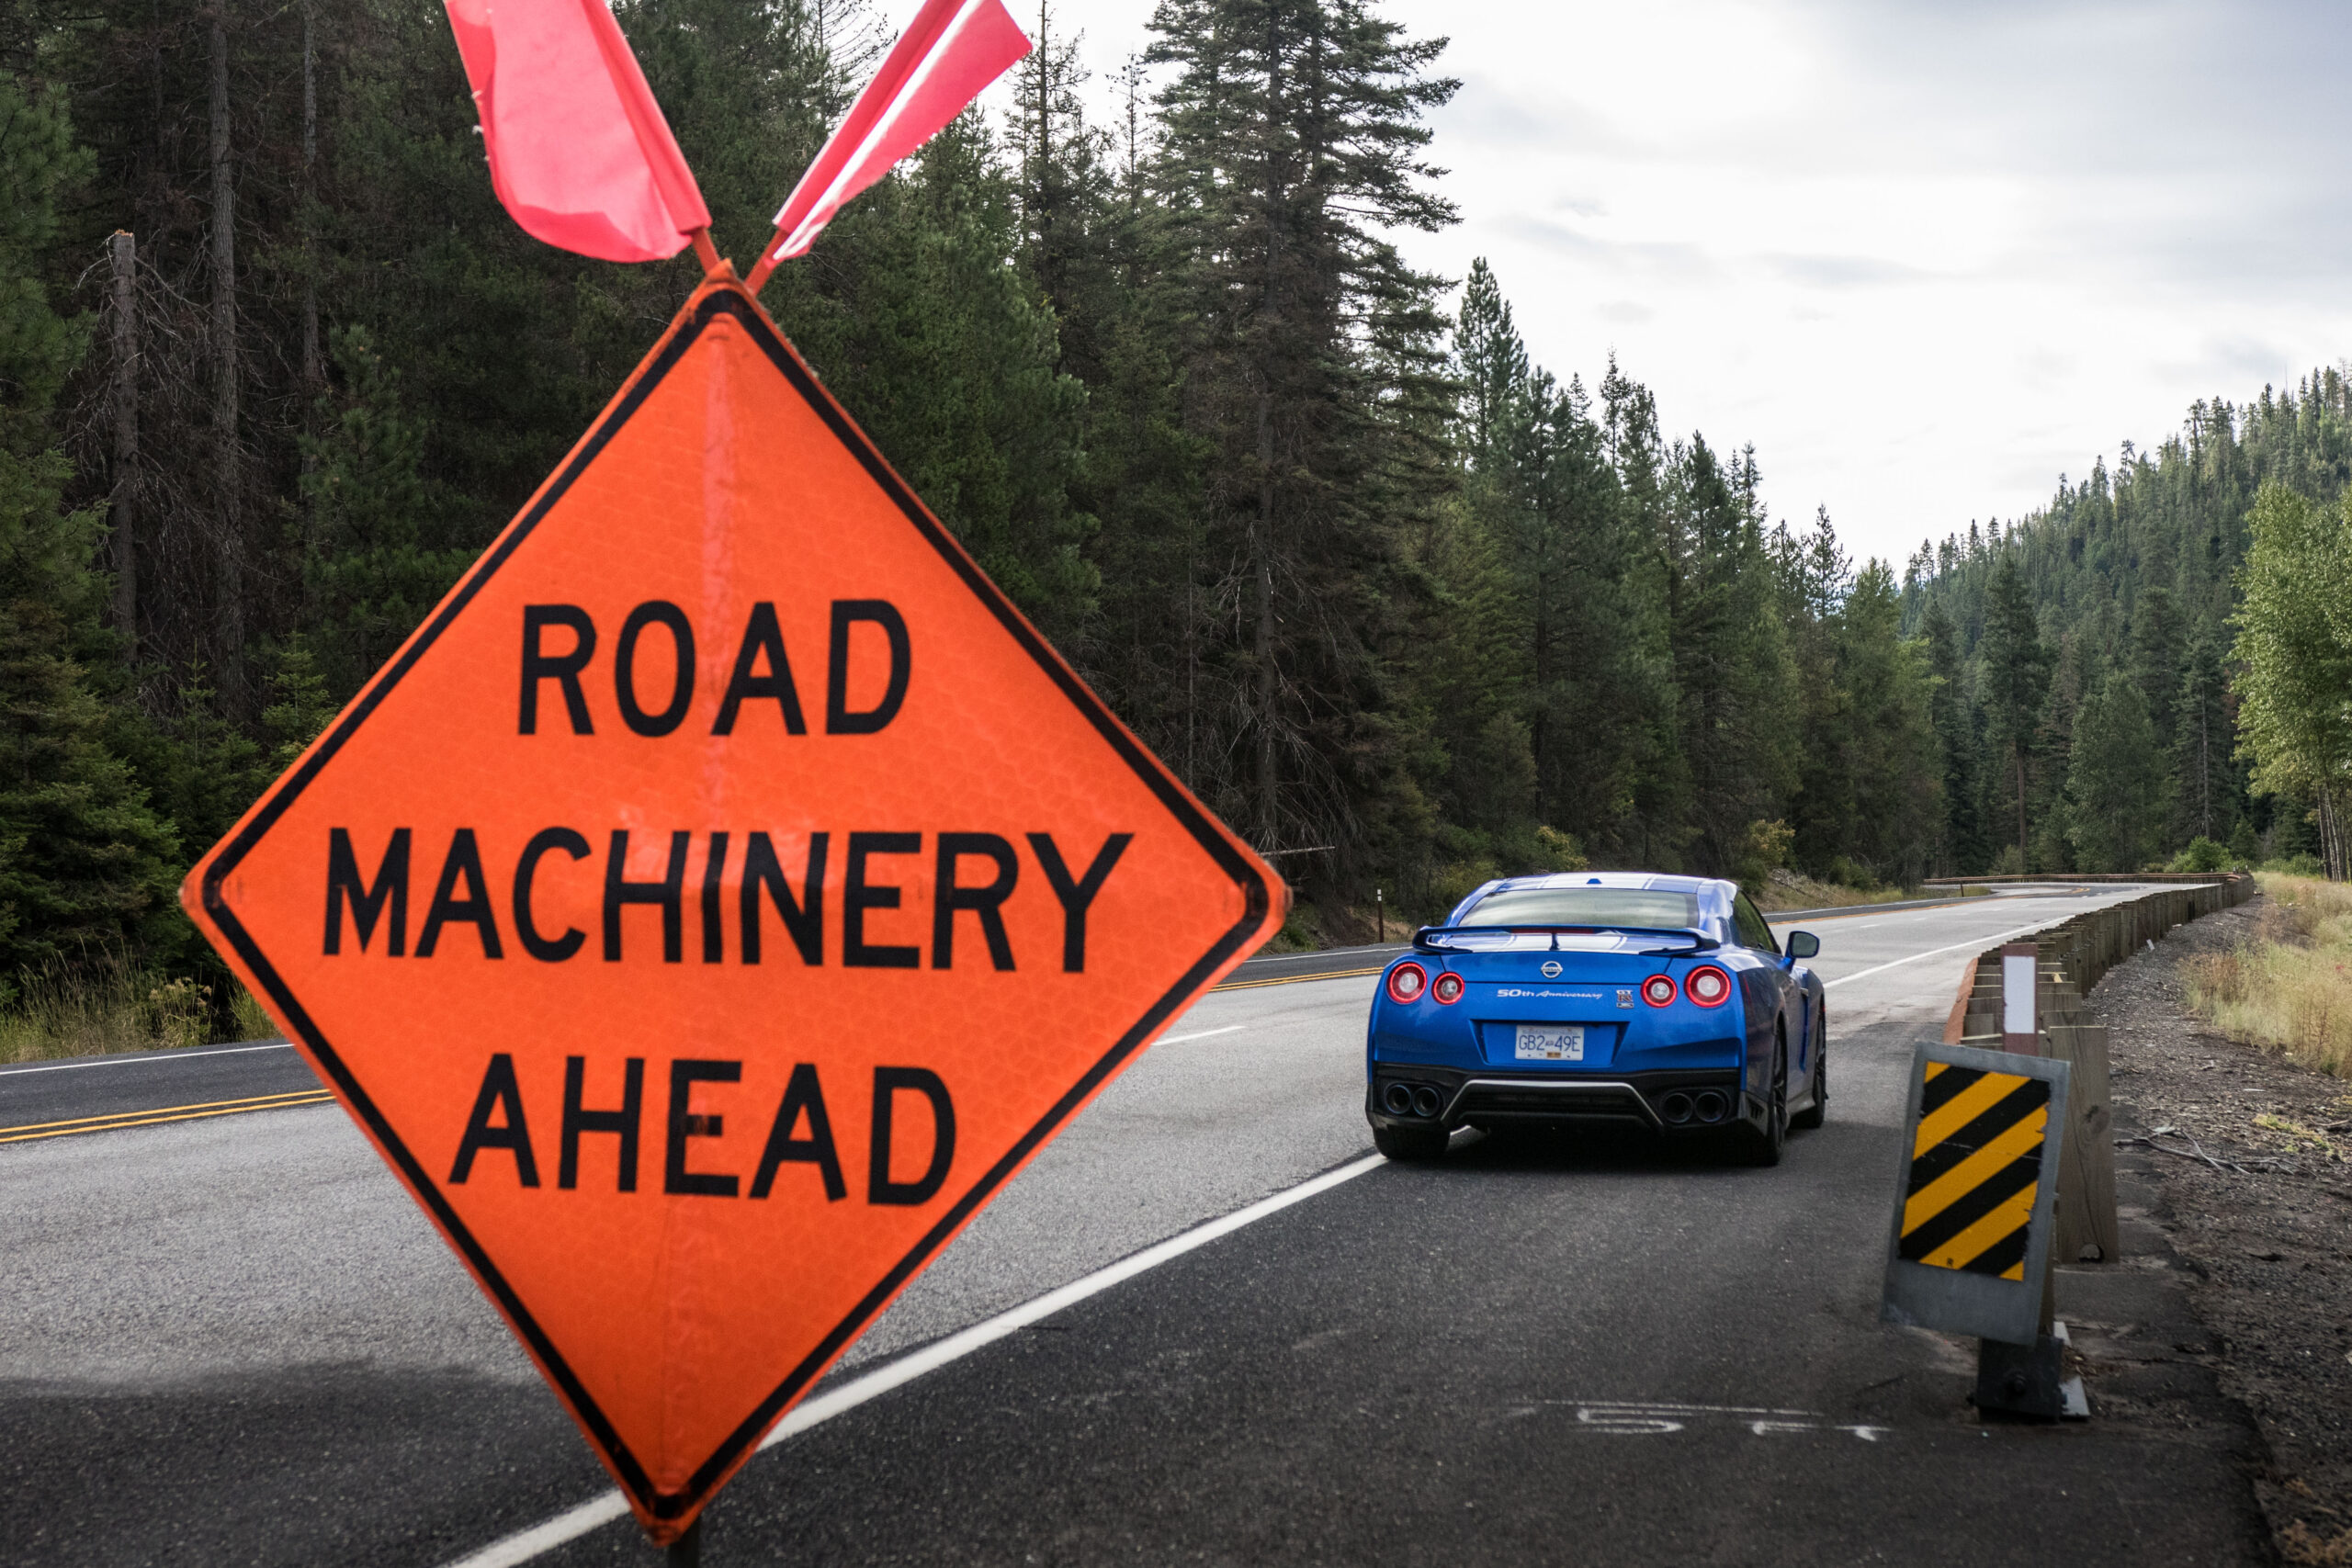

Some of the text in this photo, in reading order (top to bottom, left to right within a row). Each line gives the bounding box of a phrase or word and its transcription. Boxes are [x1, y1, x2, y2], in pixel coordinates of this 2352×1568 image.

[517, 599, 912, 739] ROAD
[322, 826, 1135, 975] MACHINERY
[1497, 988, 1603, 1000] 50th Anniversary
[447, 1053, 957, 1208] AHEAD
